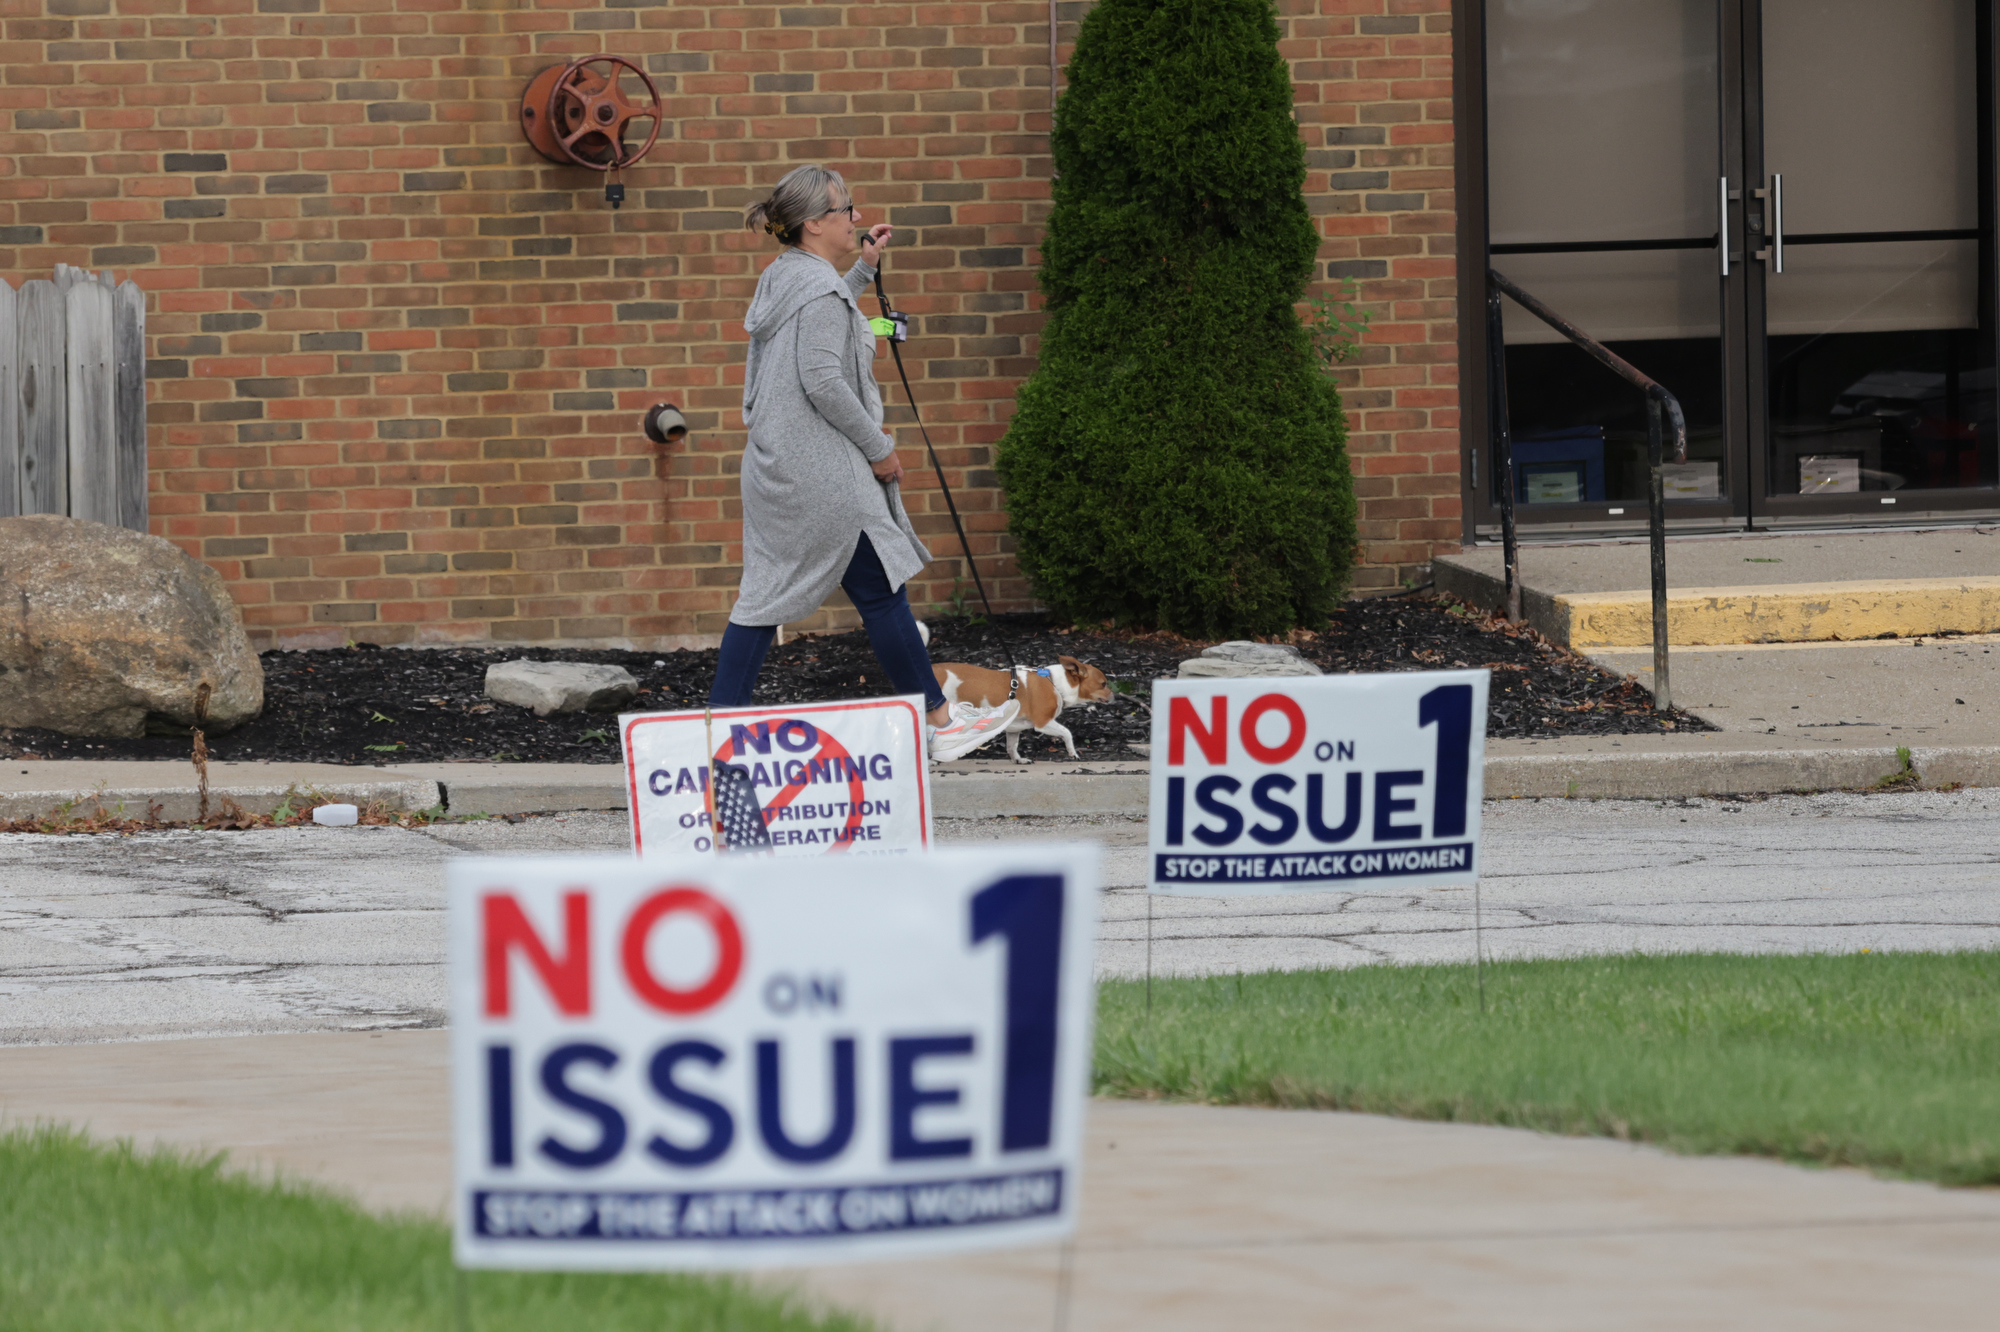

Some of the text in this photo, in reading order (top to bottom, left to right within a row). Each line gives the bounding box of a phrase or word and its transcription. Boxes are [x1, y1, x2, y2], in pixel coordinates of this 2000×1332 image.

[729, 719, 818, 756] NO
[1168, 693, 1355, 766] NO ON
[648, 753, 893, 797] CAAIGNING
[1166, 684, 1473, 847] ISSUE 1
[1165, 847, 1465, 878] STOP THE ATTACK ON WOMEN
[481, 884, 844, 1020] NO ON
[487, 873, 1065, 1168] ISSUE 1
[484, 1177, 1054, 1239] STOP THE ATTACK ON WOMEN
